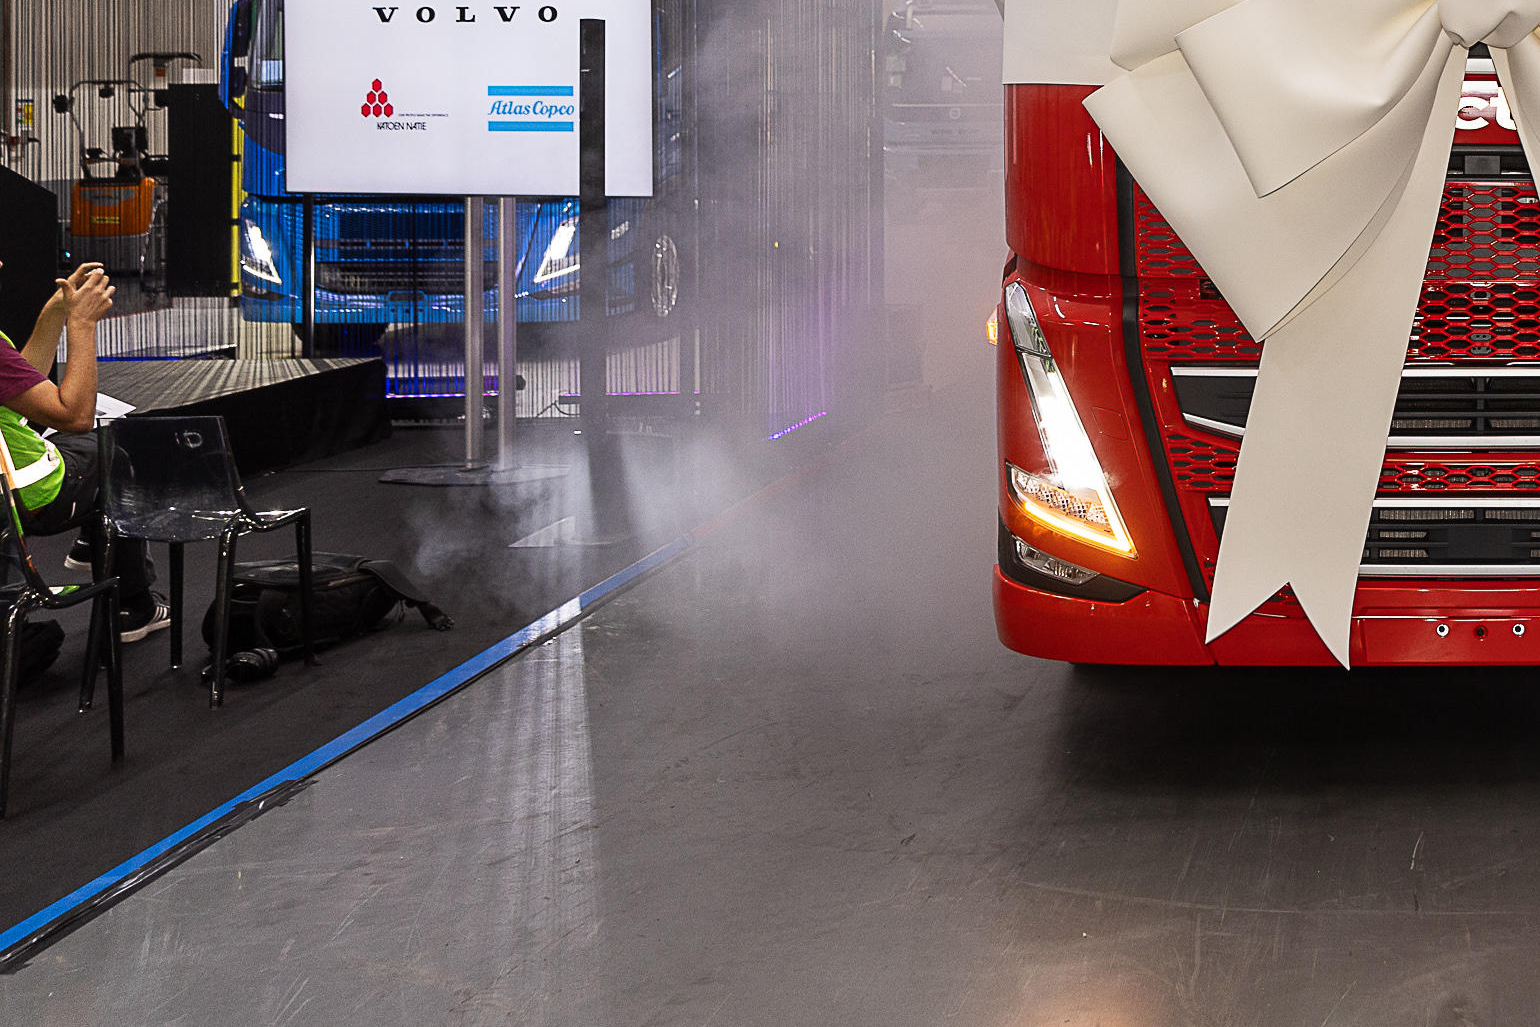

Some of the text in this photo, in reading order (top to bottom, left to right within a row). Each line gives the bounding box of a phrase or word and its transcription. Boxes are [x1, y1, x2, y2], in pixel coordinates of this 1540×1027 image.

[372, 5, 558, 23] VOLVO
[487, 100, 575, 119] Atlas Copco
[376, 121, 427, 131] KATOEN NATIE
